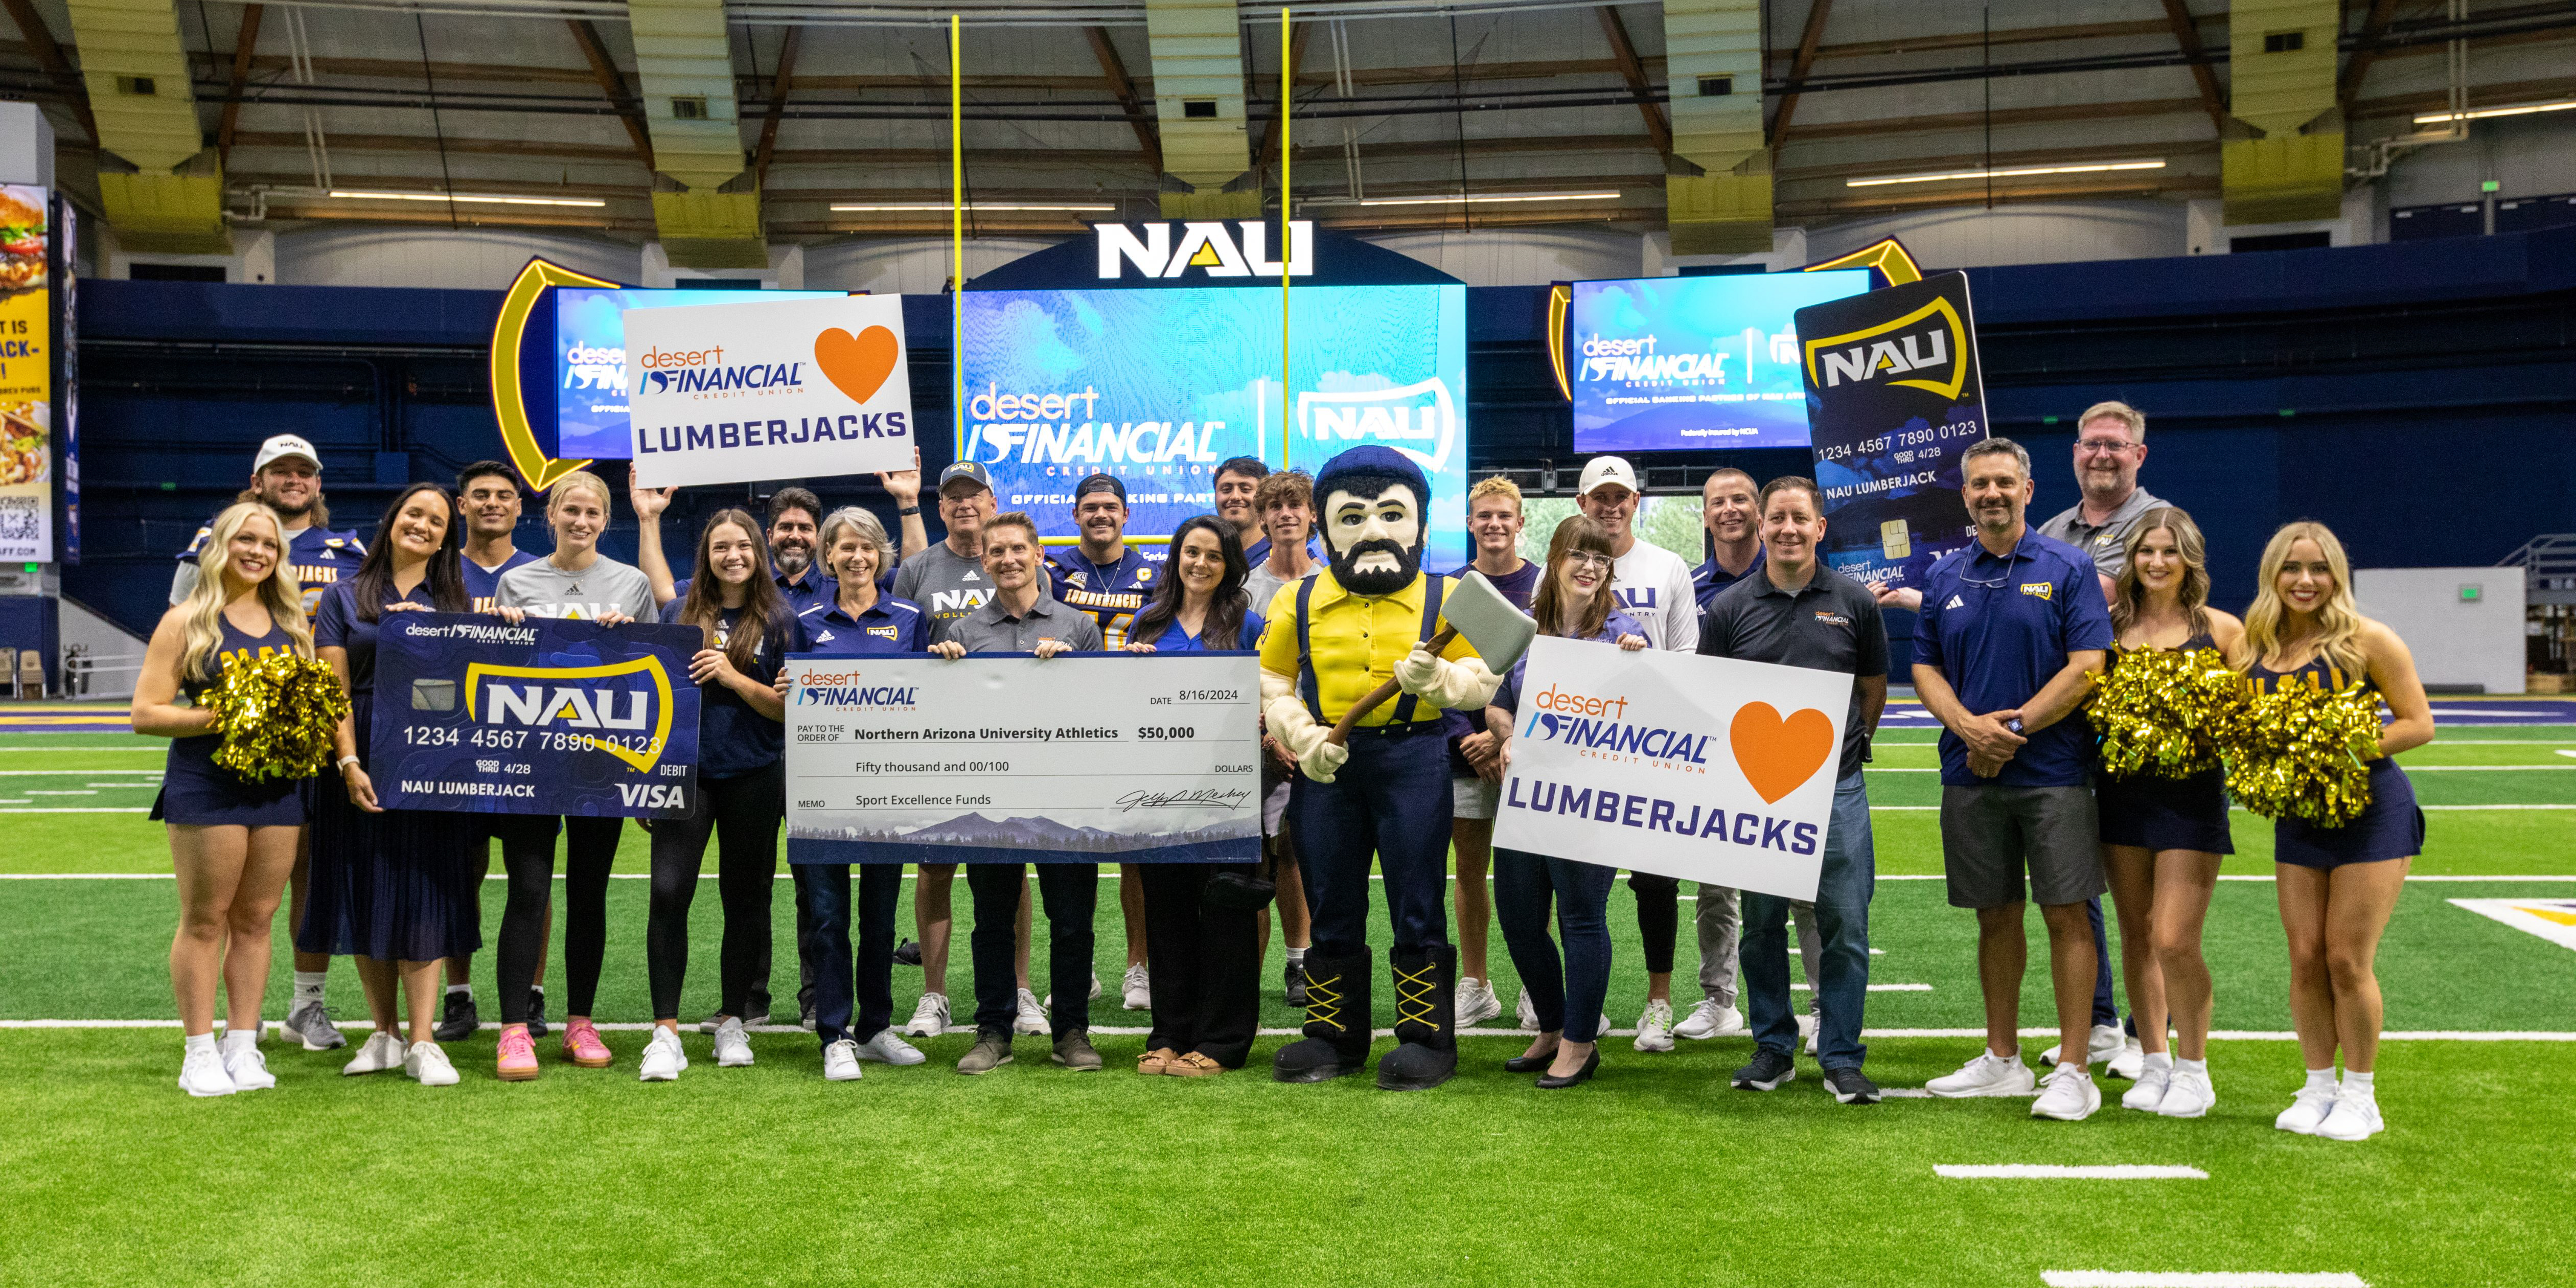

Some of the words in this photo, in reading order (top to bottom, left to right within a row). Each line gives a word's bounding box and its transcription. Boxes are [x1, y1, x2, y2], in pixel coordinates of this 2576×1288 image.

[1094, 221, 1313, 279] NAU
[12, 320, 27, 334] IS
[1582, 333, 1657, 356] desert
[641, 345, 724, 369] desert
[1822, 329, 1947, 387] NAU
[693, 392, 746, 400] CREDIT
[758, 387, 804, 396] UNION
[971, 382, 1099, 420] desert
[1314, 406, 1434, 441] NAU
[638, 411, 907, 454] LUMBERJACKS
[1819, 441, 1852, 461] 1234
[1858, 435, 1892, 454] 4567
[1898, 428, 1934, 447] 7890
[1940, 421, 1977, 440] 0123
[1894, 450, 1914, 459] GOOD
[1918, 447, 1941, 459] 4/28
[1046, 466, 1127, 476] CREDIT
[1146, 466, 1218, 475] UNION
[1826, 485, 1853, 500] NAU
[1856, 470, 1936, 495] LUMBERJACK
[1011, 494, 1075, 504] OFFICIA
[1174, 492, 1216, 503] PART
[1137, 568, 1152, 581] C
[1838, 560, 1871, 573] desert
[405, 623, 449, 637] desert
[800, 669, 860, 686] desert
[1179, 689, 1238, 701] 8/16/2024
[1536, 683, 1628, 720] desert
[487, 684, 648, 730] NAU
[404, 726, 459, 746] 1234
[471, 729, 528, 750] 4567
[540, 731, 595, 752] 7890
[605, 734, 661, 754] 0123
[855, 728, 919, 740] Northern
[923, 728, 976, 739] Arizona
[980, 728, 1052, 742] University
[1055, 727, 1118, 739] Athletics
[1138, 726, 1194, 740] $50,000
[504, 764, 531, 774] 4/28
[660, 765, 687, 776] DEBIT
[856, 762, 881, 775] Fifty
[884, 762, 940, 772] thousand
[944, 762, 966, 772] and
[969, 762, 1009, 772] 00/100
[1214, 765, 1253, 773] DOLLARS
[1580, 749, 1639, 765] CREDIT
[1652, 760, 1706, 775] UNION
[401, 780, 433, 794] NAU
[439, 782, 535, 797] LUMBERJACK
[614, 783, 685, 808] VISA
[856, 795, 887, 808] Sport
[891, 795, 952, 806] Excellence
[956, 794, 991, 805] Funds
[1507, 776, 1819, 856] LUMBERJACKS
